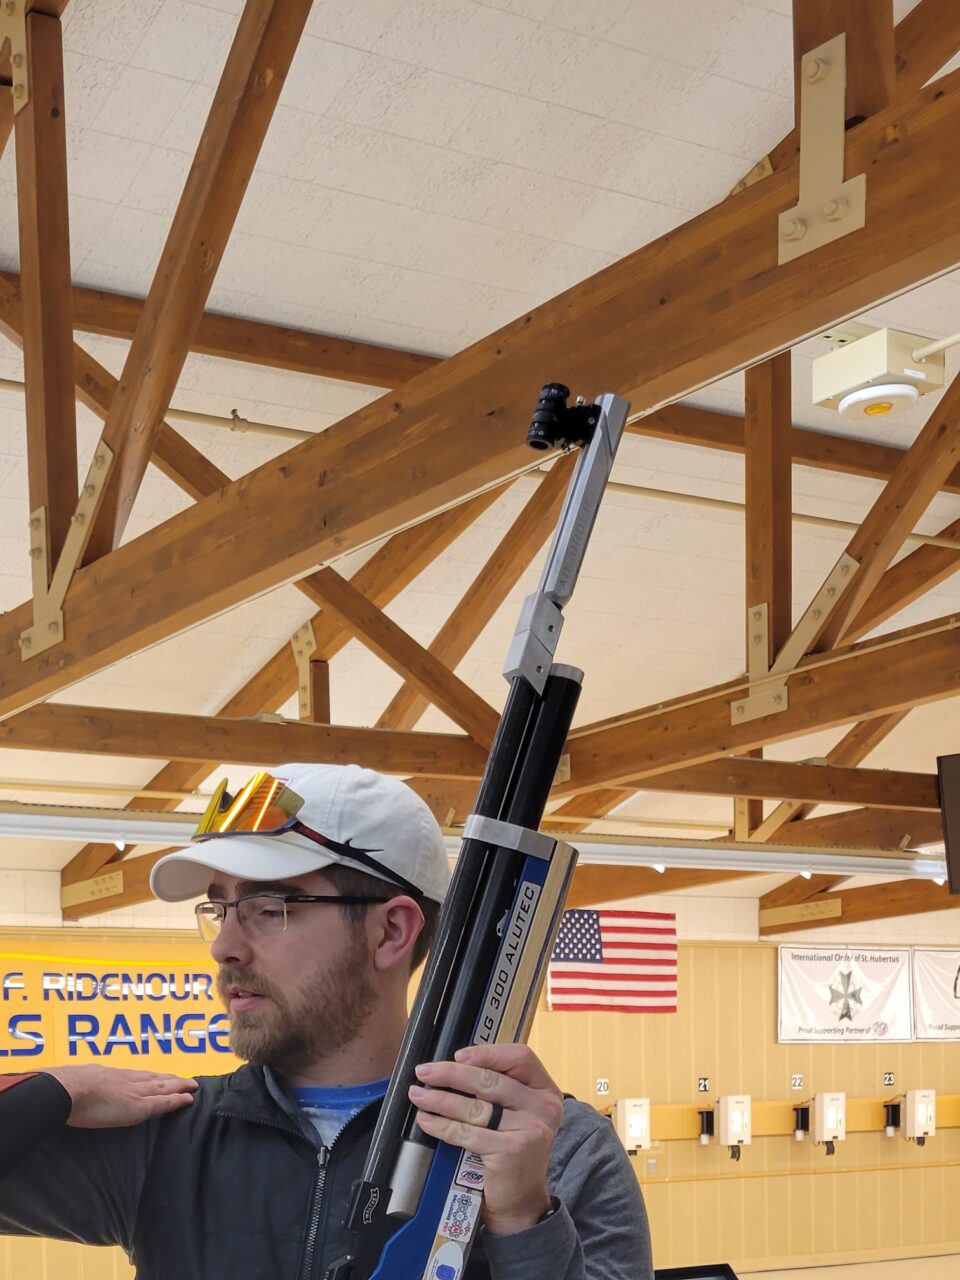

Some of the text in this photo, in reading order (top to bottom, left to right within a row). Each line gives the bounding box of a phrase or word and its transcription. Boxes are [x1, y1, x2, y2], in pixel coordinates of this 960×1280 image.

[792, 953, 833, 962] International
[861, 955, 870, 963] St.
[870, 955, 900, 963] Hubertus
[479, 886, 535, 1043] LG 300 ALUTEC
[3, 972, 28, 1001] F.
[43, 972, 213, 1001] RIDENOUR
[67, 1013, 234, 1057] RANGE
[845, 1026, 865, 1034] Partner
[792, 1077, 803, 1087] 22
[885, 1074, 895, 1085] 23
[597, 1081, 609, 1092] 20
[699, 1079, 709, 1092] 21
